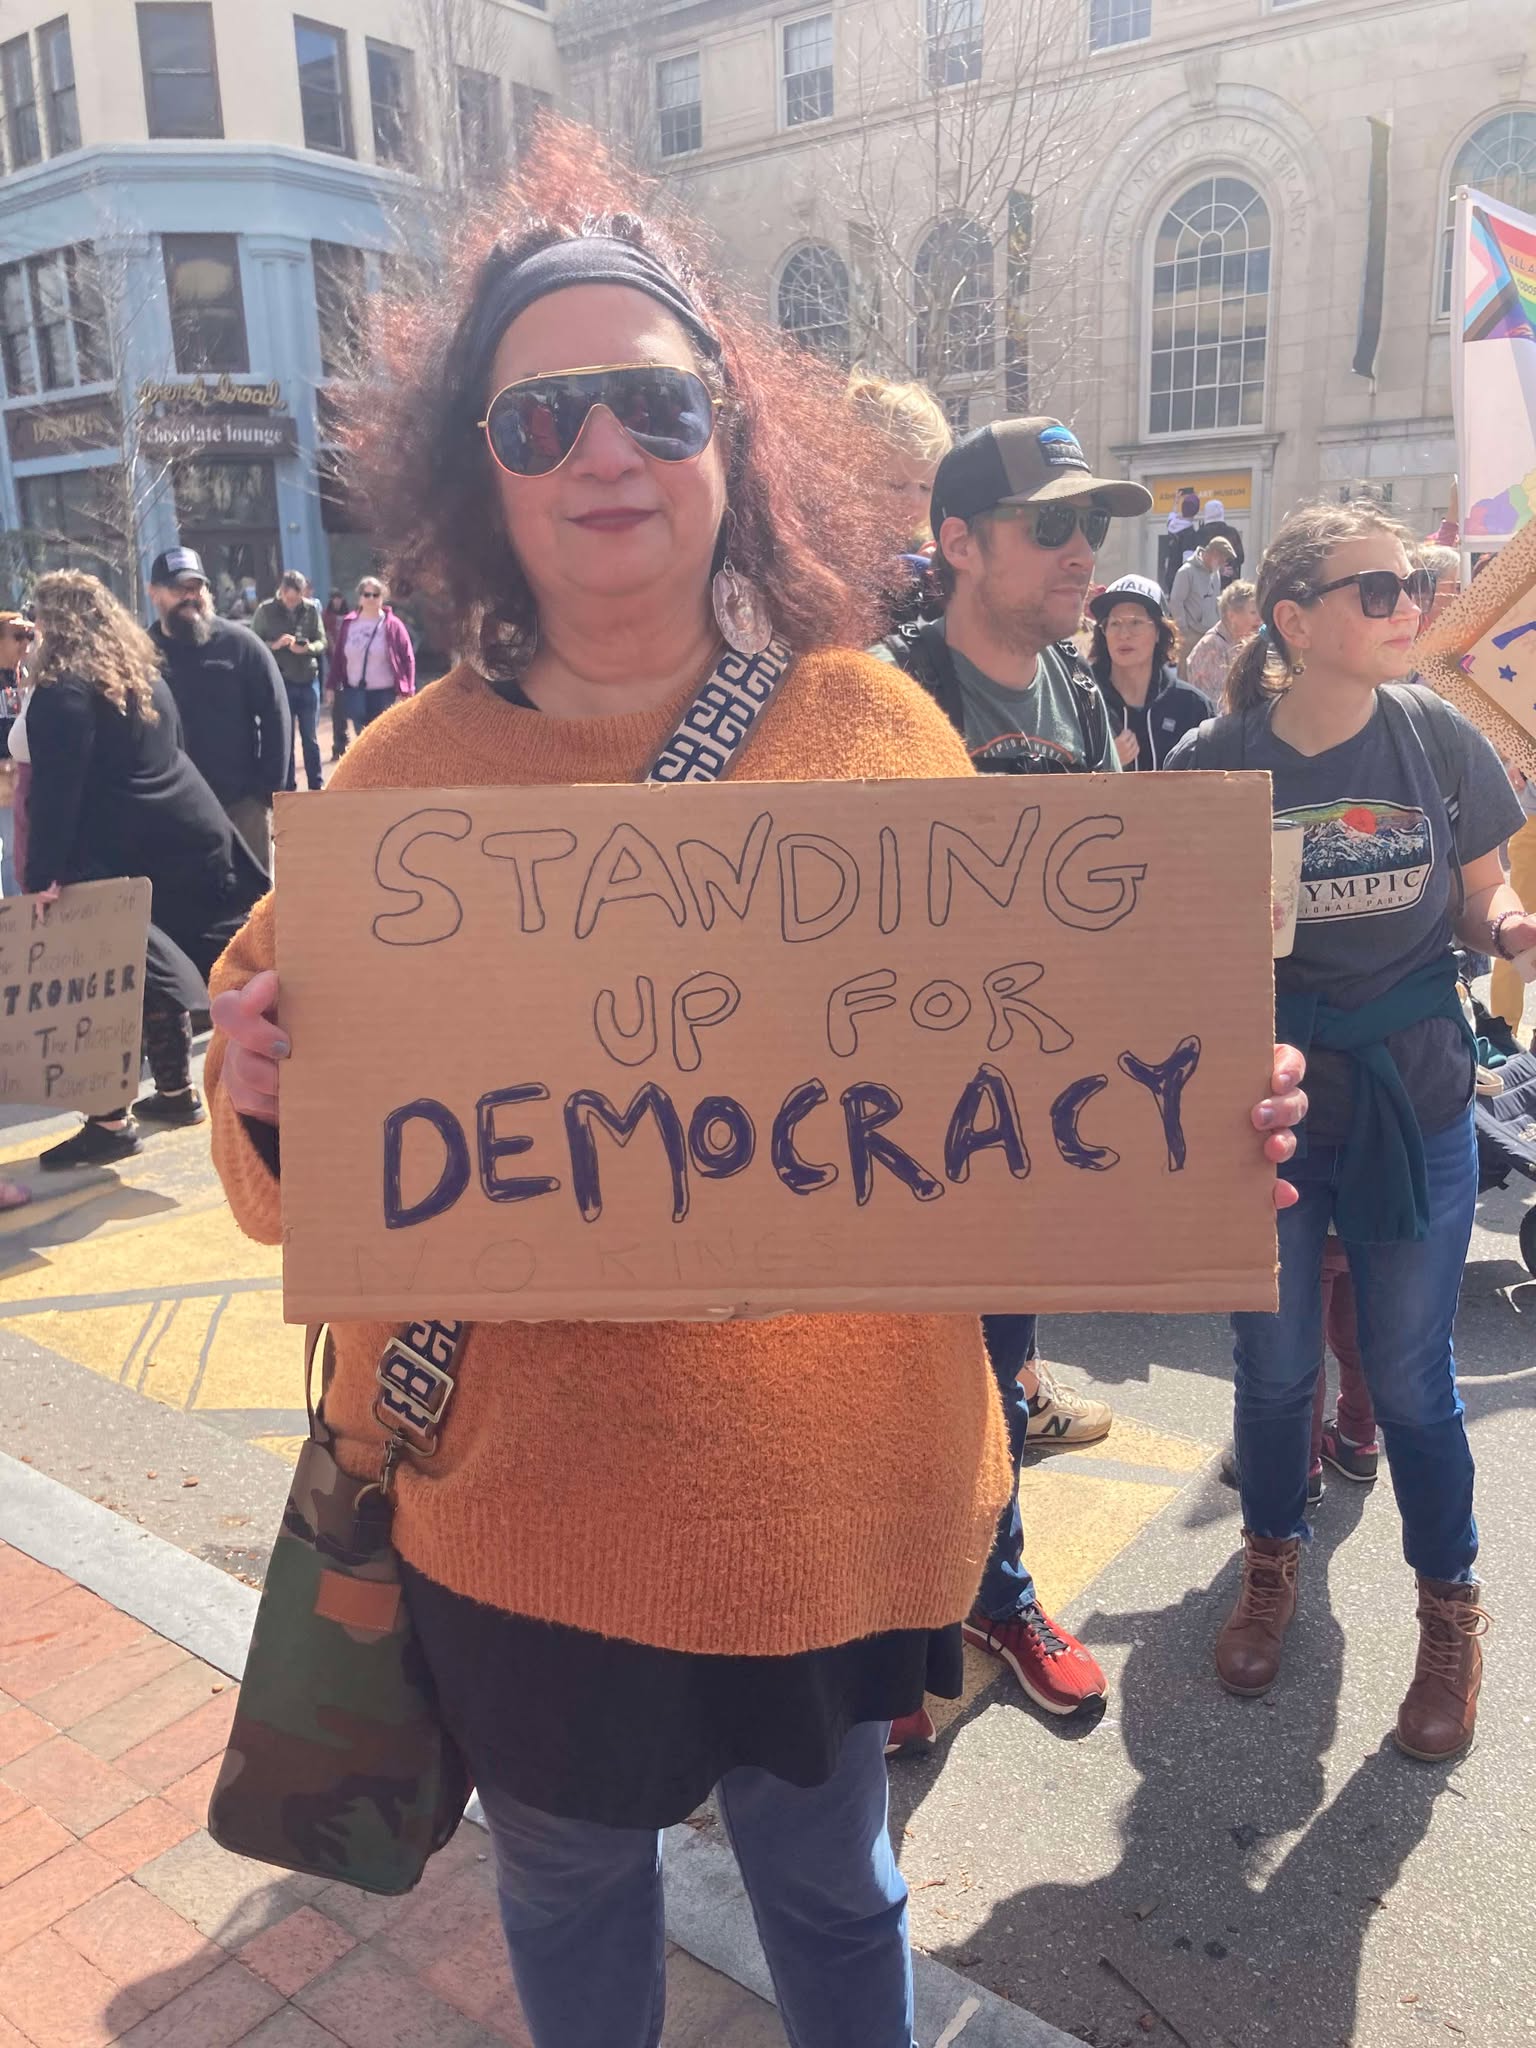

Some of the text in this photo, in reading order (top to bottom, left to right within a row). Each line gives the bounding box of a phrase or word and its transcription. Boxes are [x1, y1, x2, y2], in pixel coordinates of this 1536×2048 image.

[1131, 125, 1252, 191] MEMORIAL
[1256, 137, 1306, 235] LIBRARY
[146, 423, 282, 447] chocolate lounge
[371, 804, 1148, 946] STANDING
[1305, 895, 1405, 914] IONAL PARK
[1306, 870, 1420, 902] YMPIC
[4, 964, 136, 1016] TRONGER
[594, 961, 1073, 1073] UP FOR
[382, 1034, 1201, 1231] DEMOCRACY
